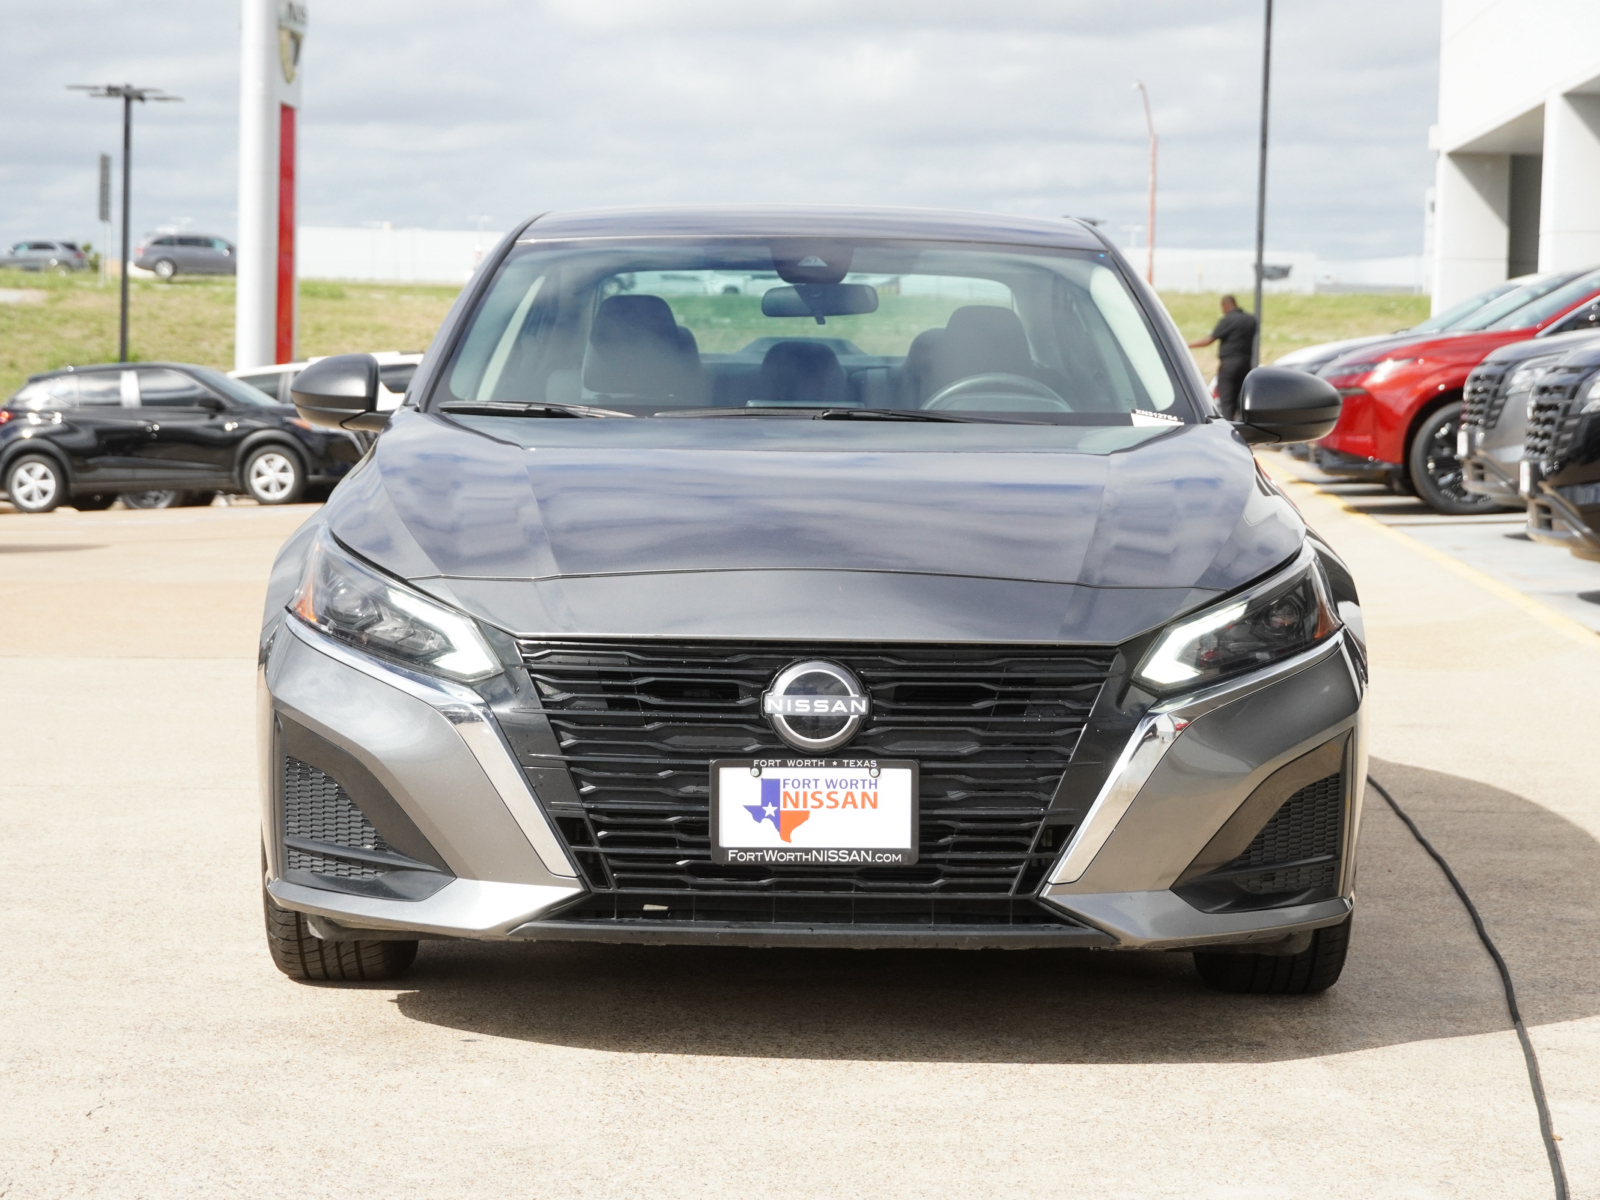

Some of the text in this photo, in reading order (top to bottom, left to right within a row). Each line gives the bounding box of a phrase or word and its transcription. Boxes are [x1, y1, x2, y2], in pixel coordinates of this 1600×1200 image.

[767, 699, 866, 713] NISSAN
[753, 759, 878, 768] FORT WORTH TEXAS
[782, 778, 879, 790] FORT WORTH
[782, 791, 879, 809] NISSAN
